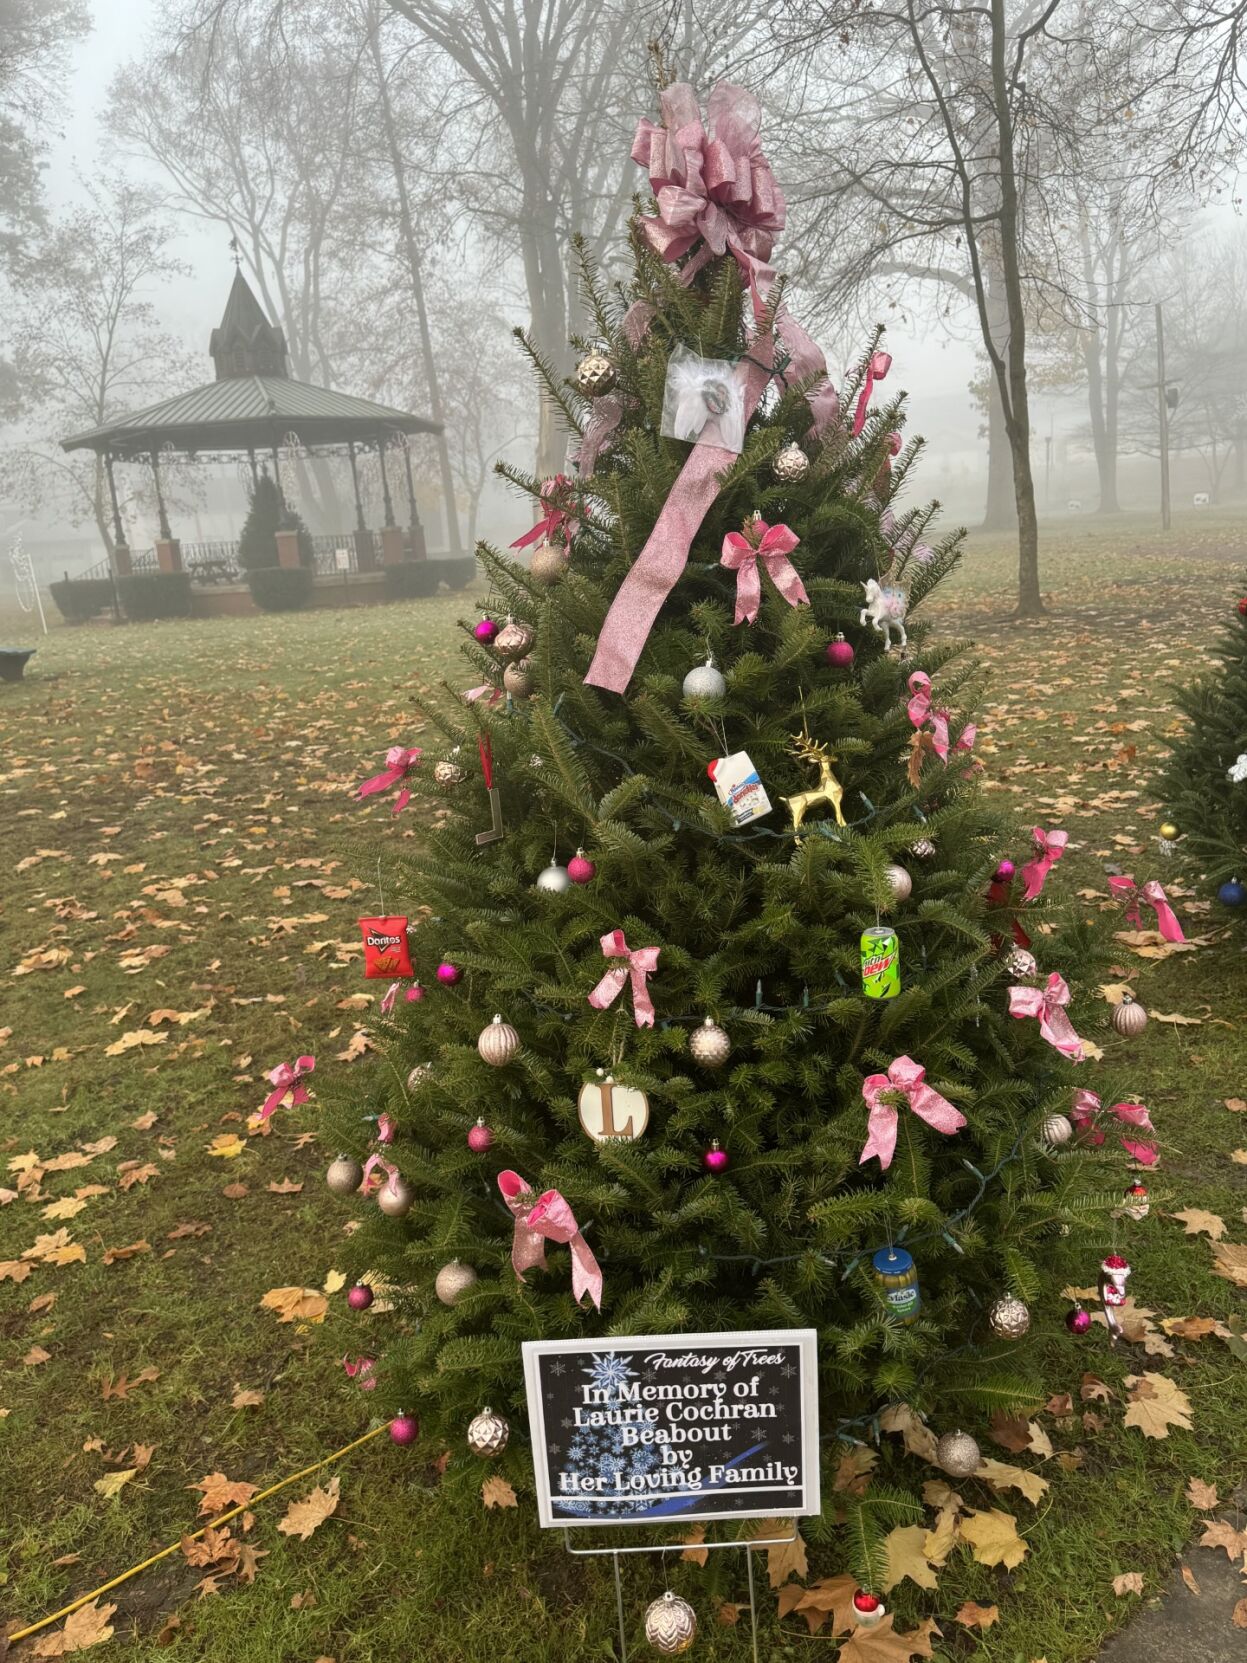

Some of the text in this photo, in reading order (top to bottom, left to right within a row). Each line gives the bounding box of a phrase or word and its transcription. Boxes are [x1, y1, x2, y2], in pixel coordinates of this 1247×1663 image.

[367, 936, 400, 946] Doritos
[596, 1083, 634, 1137] L
[644, 1349, 786, 1374] Fantasy of Trees
[582, 1376, 760, 1404] In Memory of
[572, 1398, 778, 1428] Laurie Cochran
[622, 1423, 732, 1446] Beabout
[660, 1446, 693, 1469] by
[558, 1462, 798, 1492] Her Loving Family
